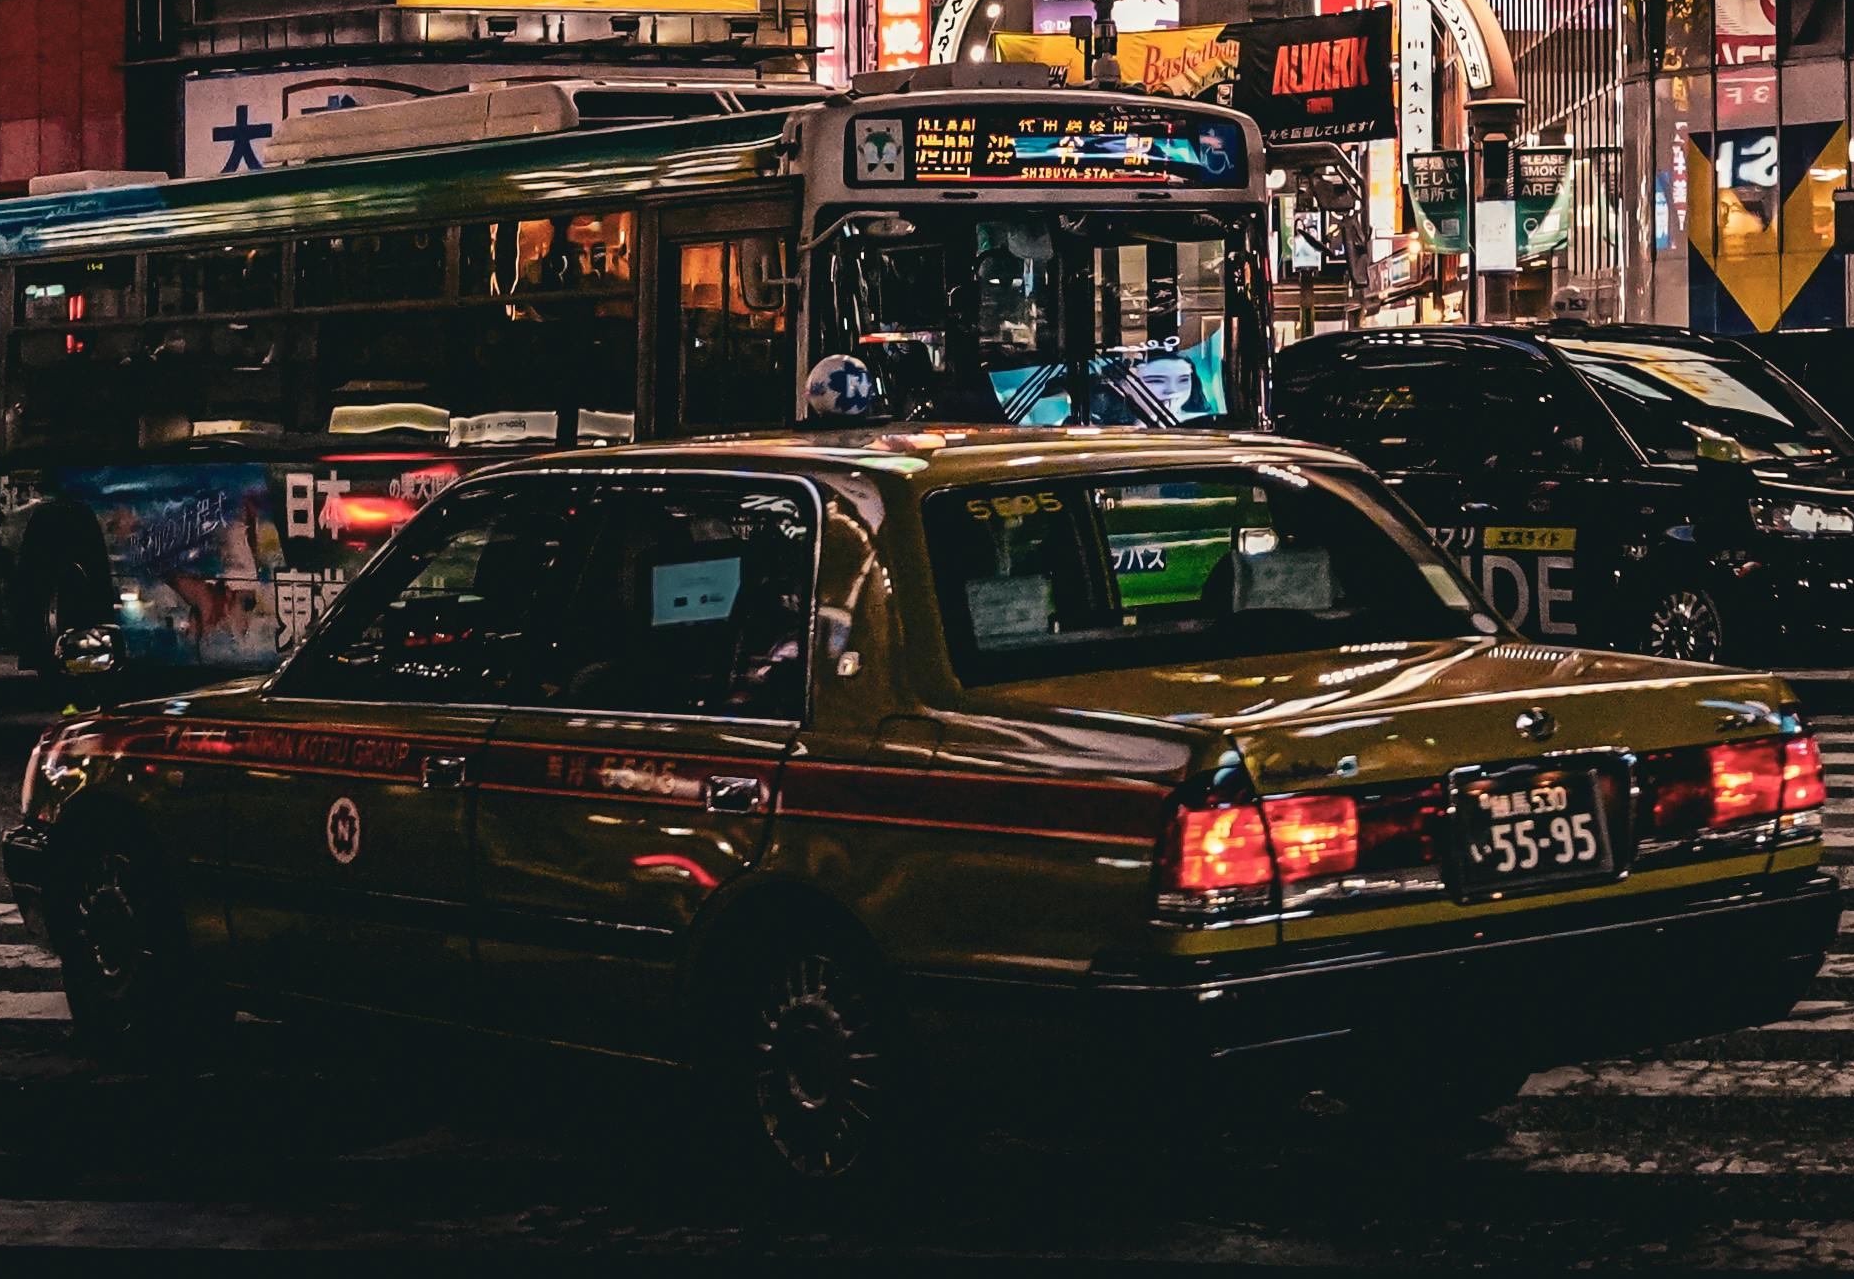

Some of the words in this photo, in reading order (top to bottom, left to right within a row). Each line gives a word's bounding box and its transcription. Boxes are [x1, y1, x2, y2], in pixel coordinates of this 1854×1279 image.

[1021, 167, 1078, 179] SHIBUYA
[1521, 183, 1565, 196] AREA
[1490, 813, 1594, 873] 55-95
